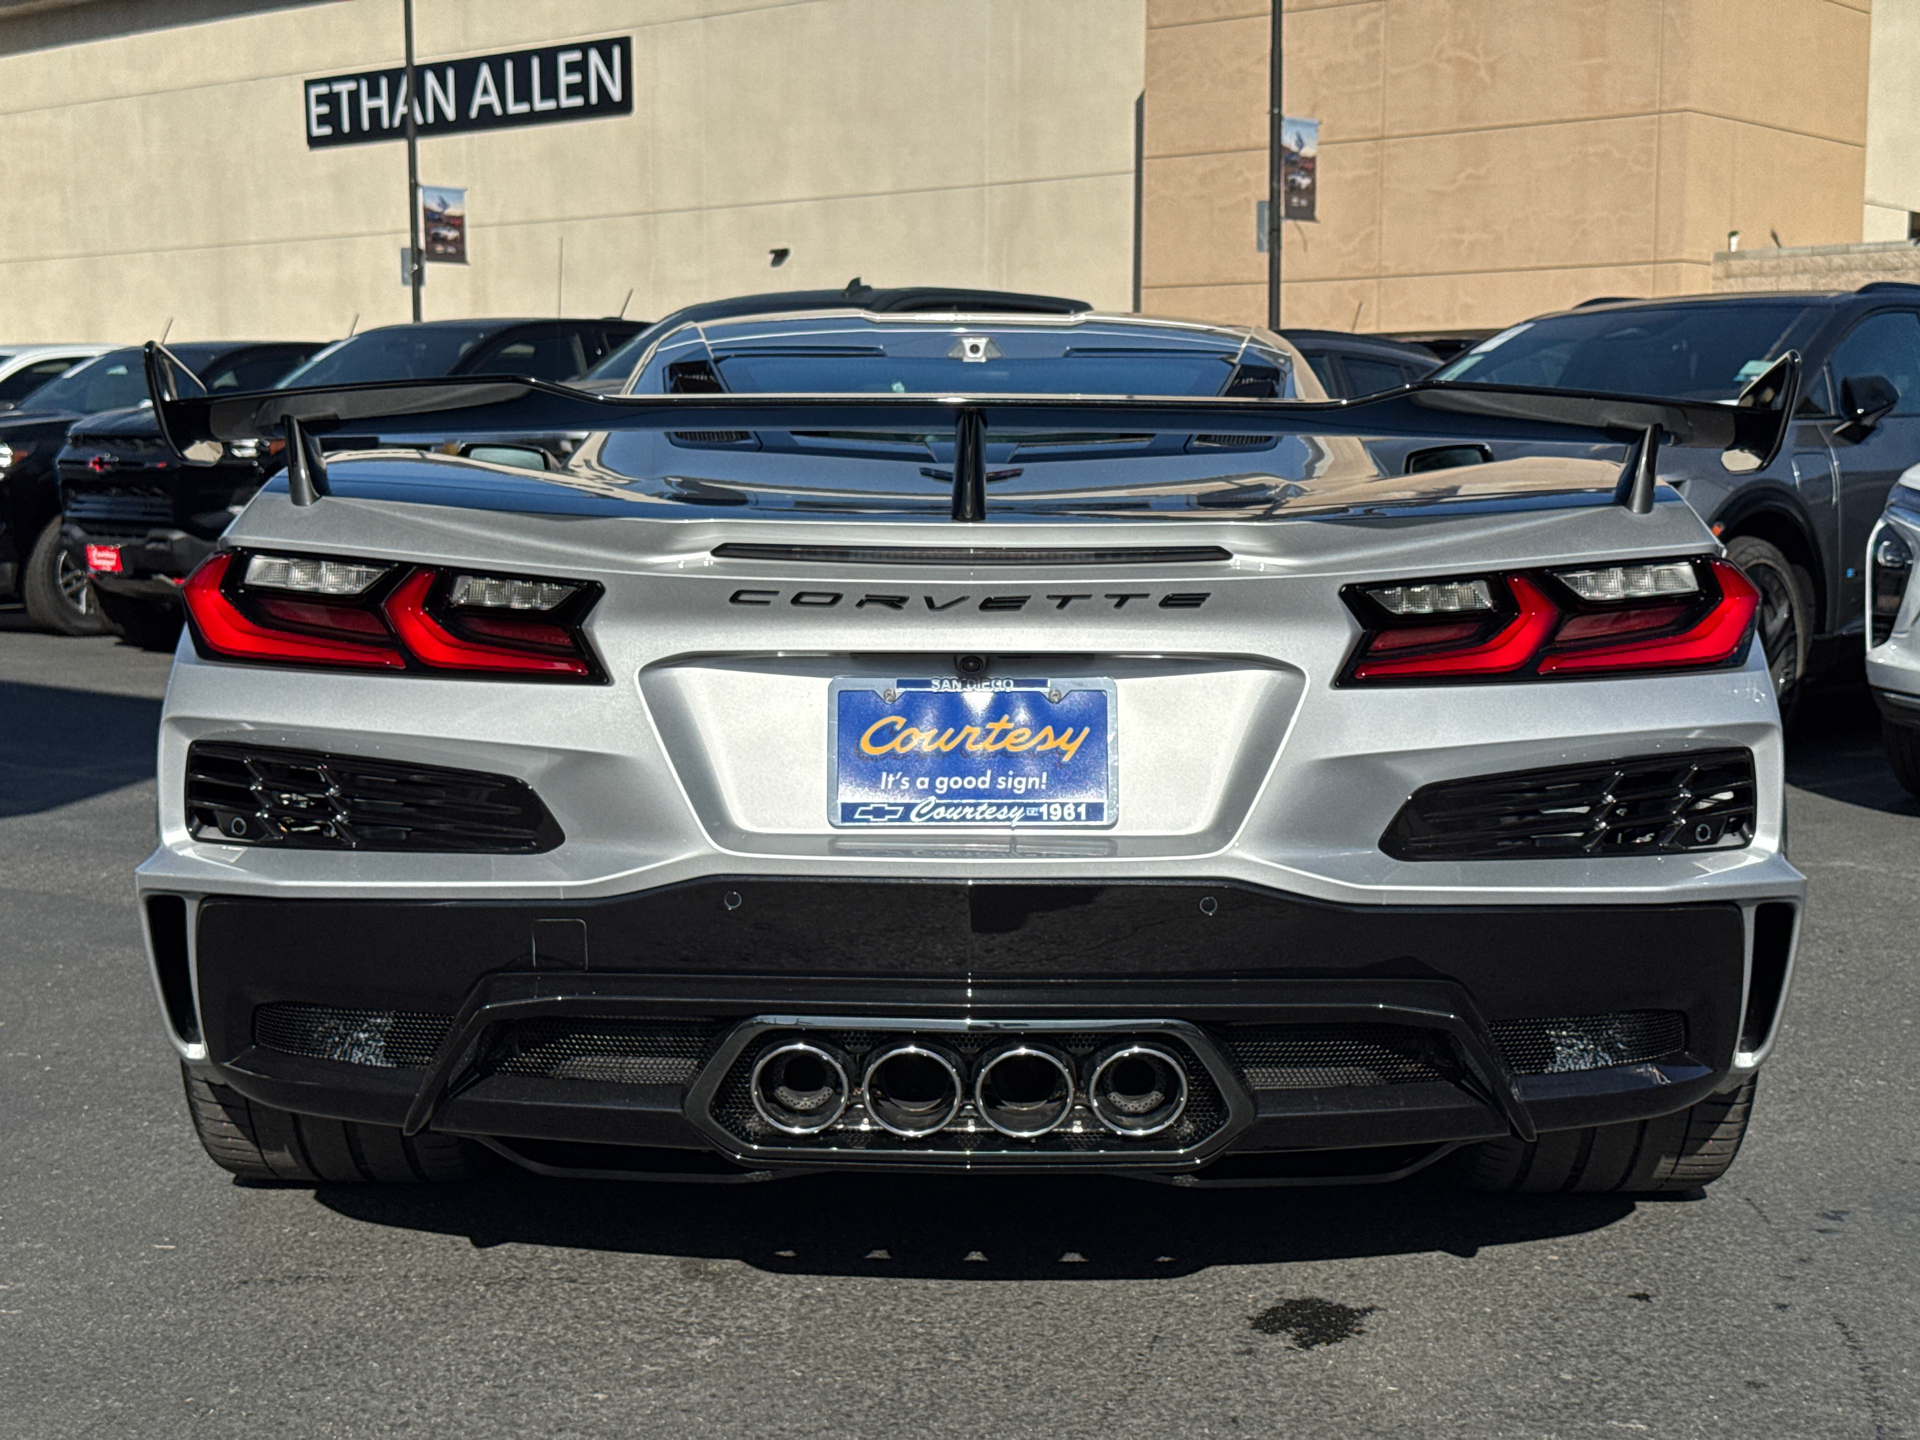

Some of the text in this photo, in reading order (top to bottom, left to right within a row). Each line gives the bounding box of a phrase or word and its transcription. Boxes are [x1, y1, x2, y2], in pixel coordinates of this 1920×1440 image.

[308, 44, 623, 137] ETHAN ALLEN
[729, 589, 1212, 612] CORVETTE
[931, 678, 1014, 691] SAN DIEGO
[859, 715, 1091, 763] Courtesy
[880, 771, 1048, 794] It's a good sign!
[910, 796, 1026, 827] Courtesy
